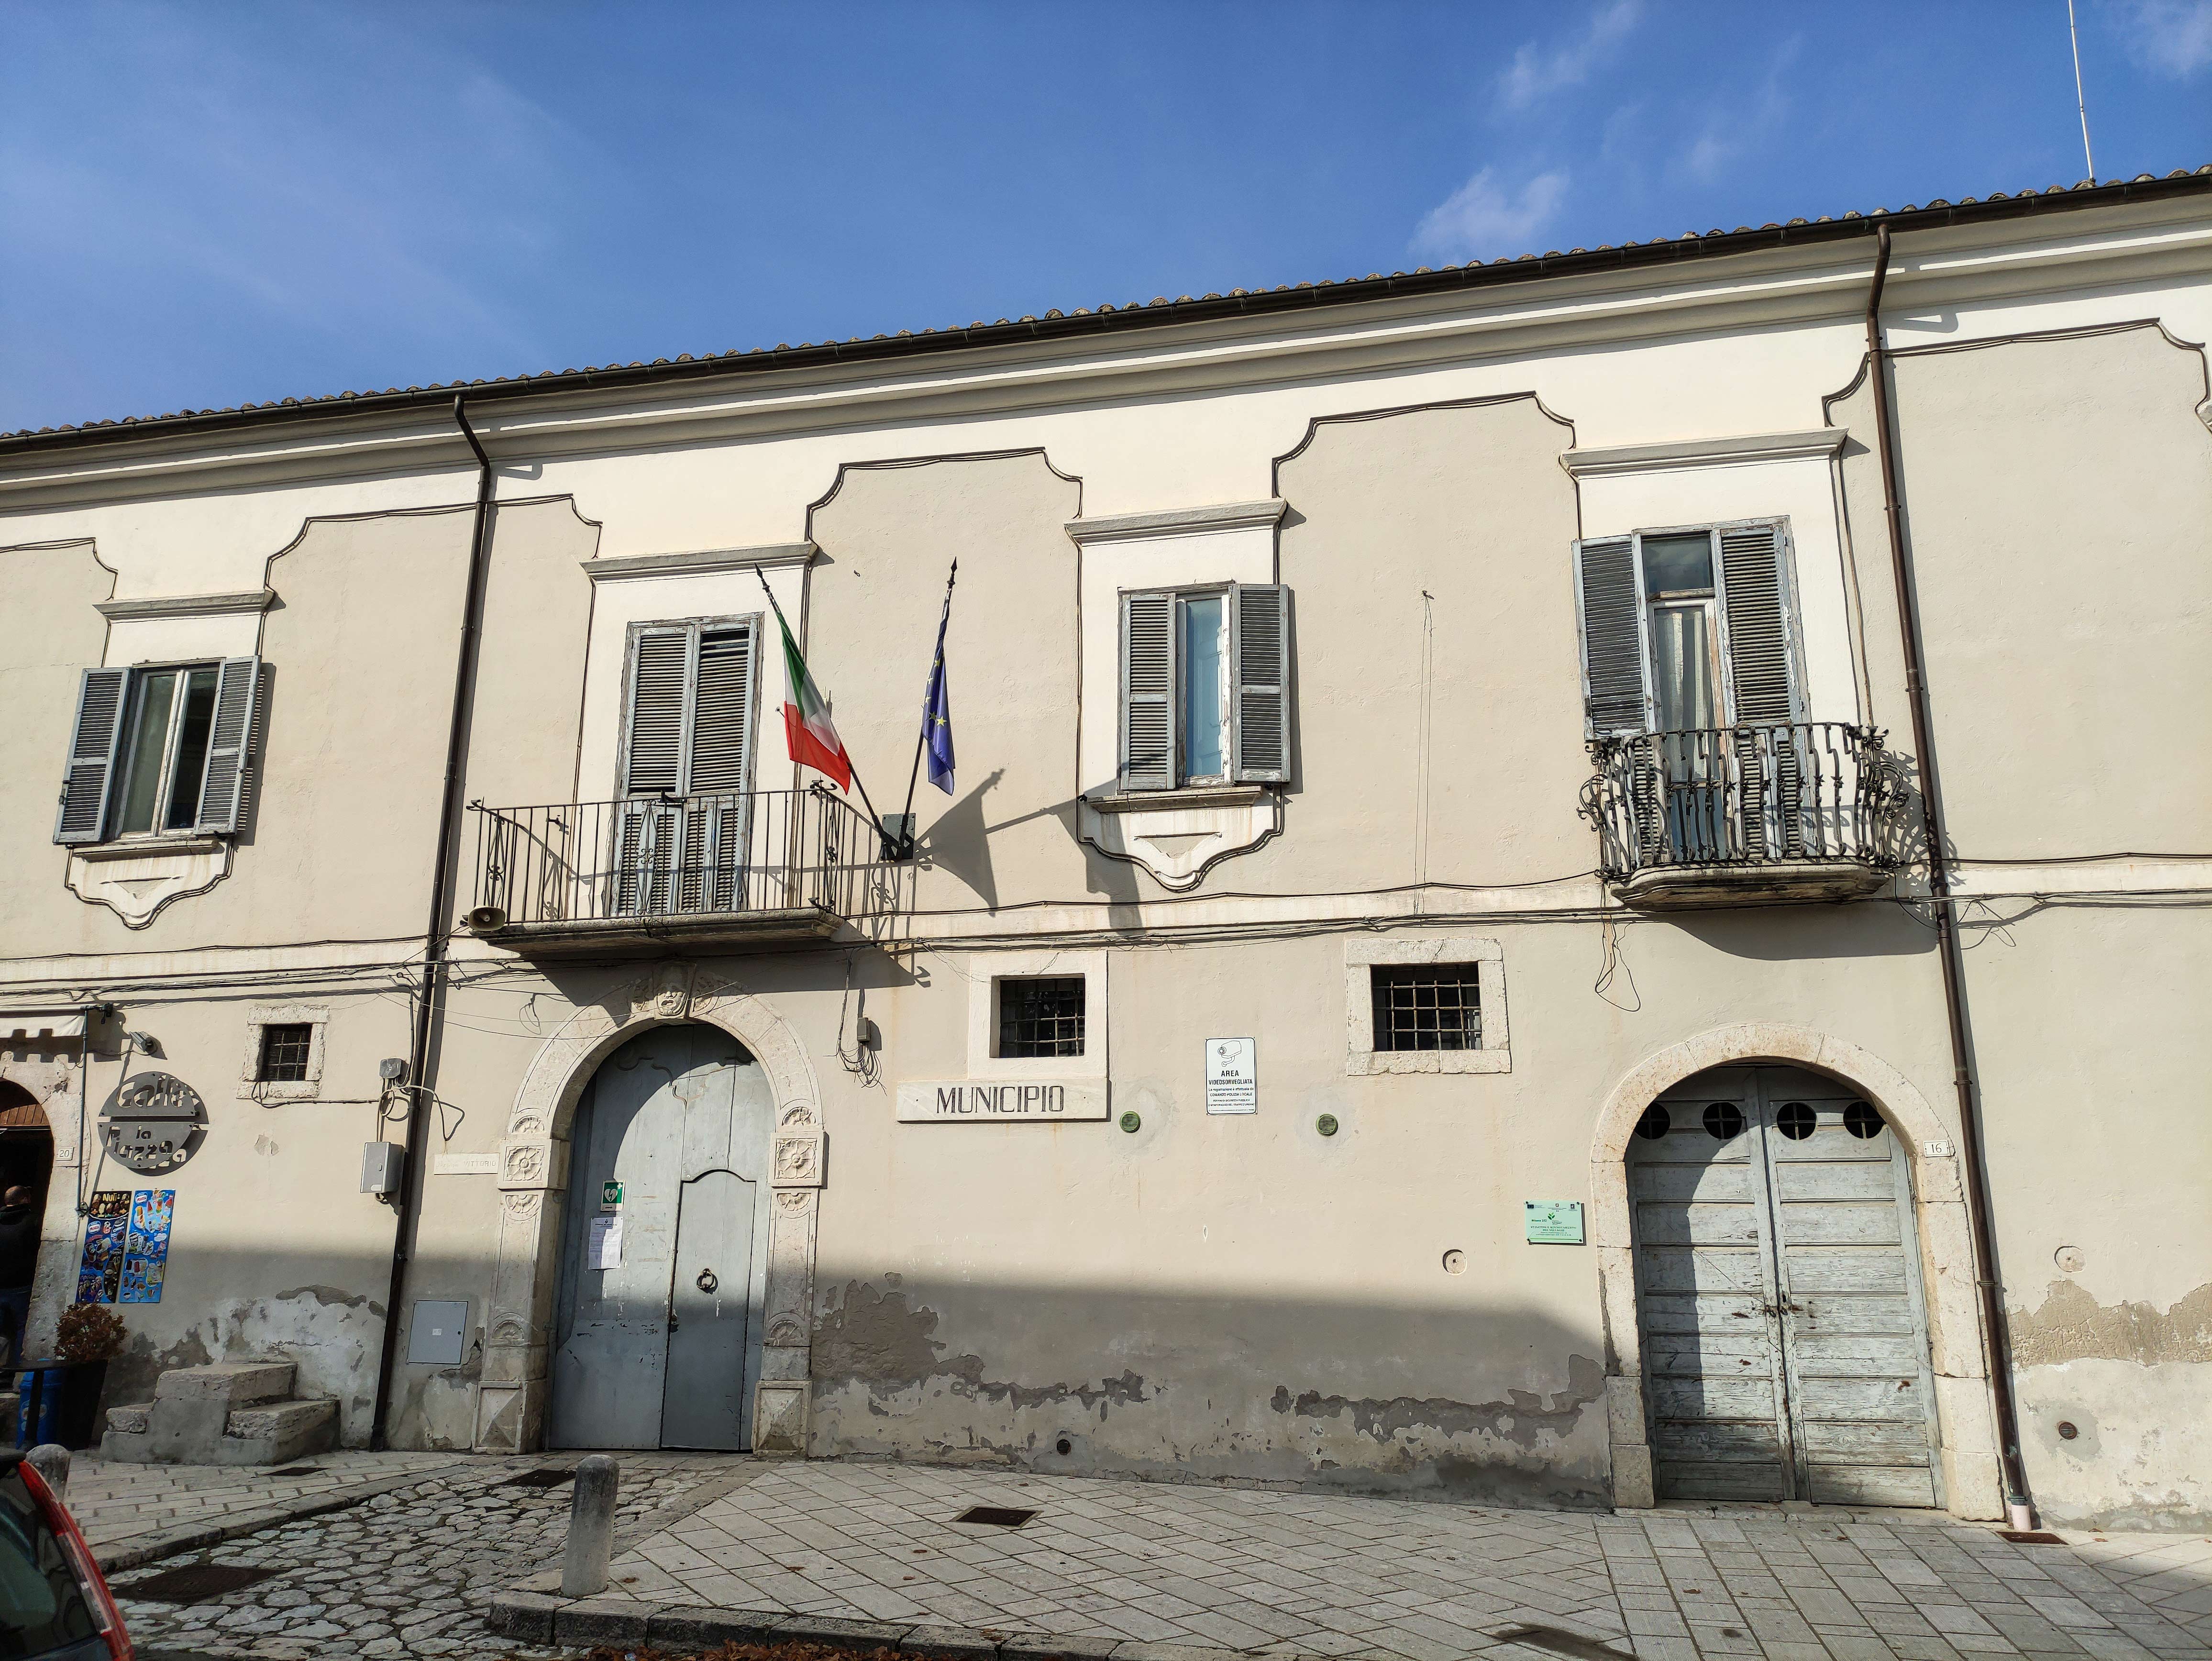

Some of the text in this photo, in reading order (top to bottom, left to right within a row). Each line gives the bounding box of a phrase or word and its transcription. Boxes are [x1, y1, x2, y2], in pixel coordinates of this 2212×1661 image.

[936, 1085, 1064, 1114] MUNICIPIO
[106, 1126, 173, 1161] Piazza
[1931, 1143, 1942, 1153] 16
